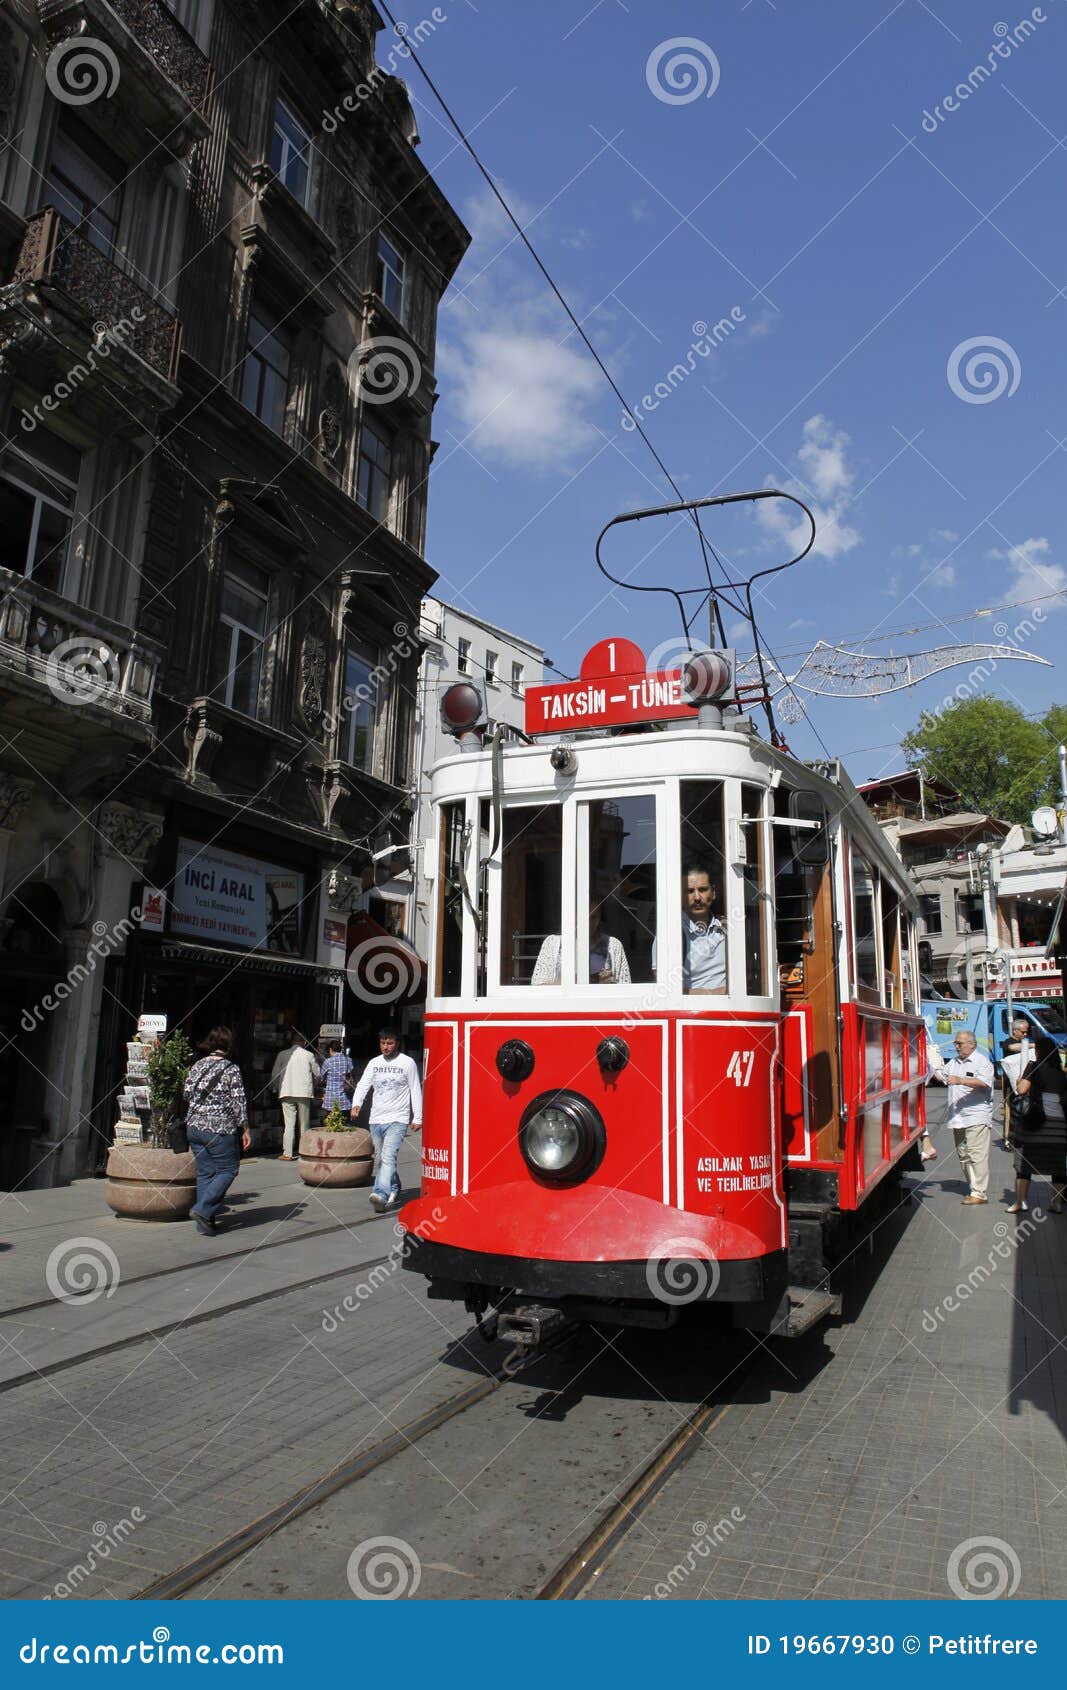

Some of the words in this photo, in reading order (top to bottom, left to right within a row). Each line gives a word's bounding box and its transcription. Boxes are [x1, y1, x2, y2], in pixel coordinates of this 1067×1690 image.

[607, 642, 617, 672] 1
[540, 685, 606, 720] TAKSİM
[628, 679, 682, 709] TÜNE
[184, 864, 216, 892] İNCİ
[219, 877, 256, 902] ARAL
[1011, 963, 1038, 974] IRAT
[1041, 959, 1056, 971] BÜ
[372, 1066, 404, 1075] DRIVER
[726, 1050, 755, 1088] 47
[697, 1156, 743, 1172] ASILMAK
[697, 1178, 712, 1193] VE
